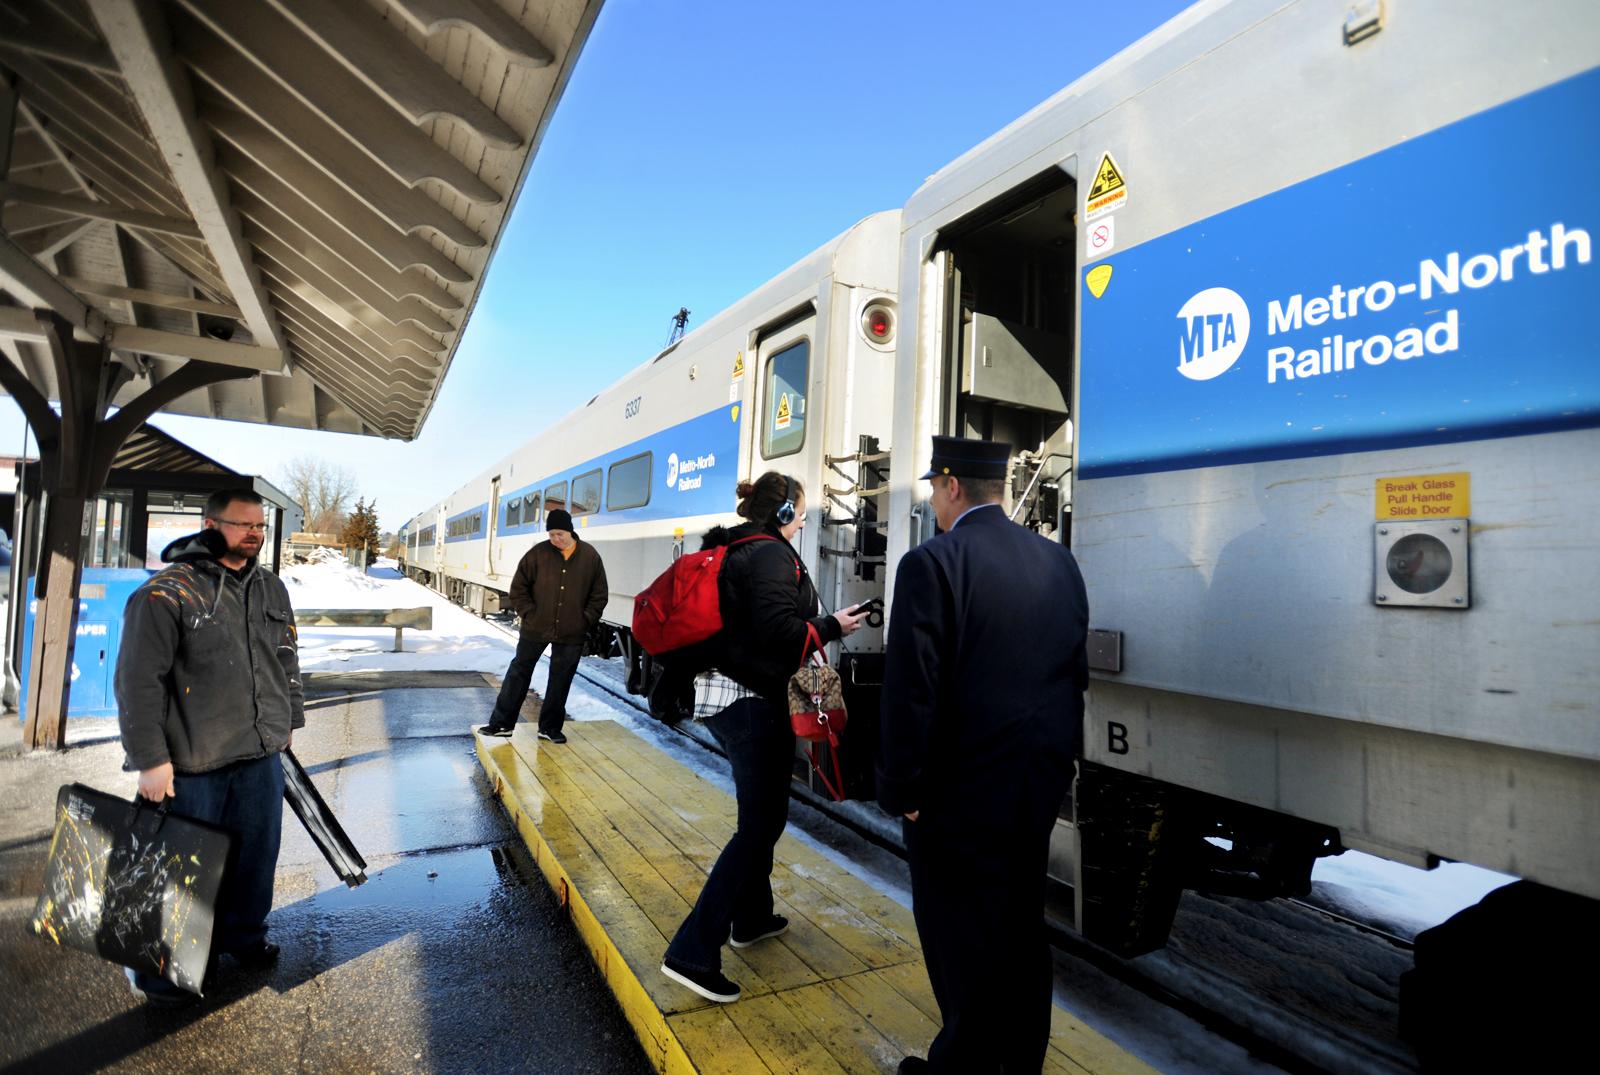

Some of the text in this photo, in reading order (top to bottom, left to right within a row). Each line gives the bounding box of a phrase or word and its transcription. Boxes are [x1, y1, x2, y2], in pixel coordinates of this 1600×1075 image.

[1267, 222, 1592, 336] Metro-North
[1176, 312, 1236, 364] MTA
[1267, 308, 1459, 384] Railroad
[625, 396, 641, 419] 6337
[679, 452, 715, 474] Metro-North
[678, 473, 702, 491] Railroad
[1385, 480, 1456, 492] Break Glass
[1388, 491, 1454, 504] Pull Handle
[1390, 504, 1451, 516] Slide Door
[76, 624, 107, 635] APER
[1108, 720, 1129, 755] B
